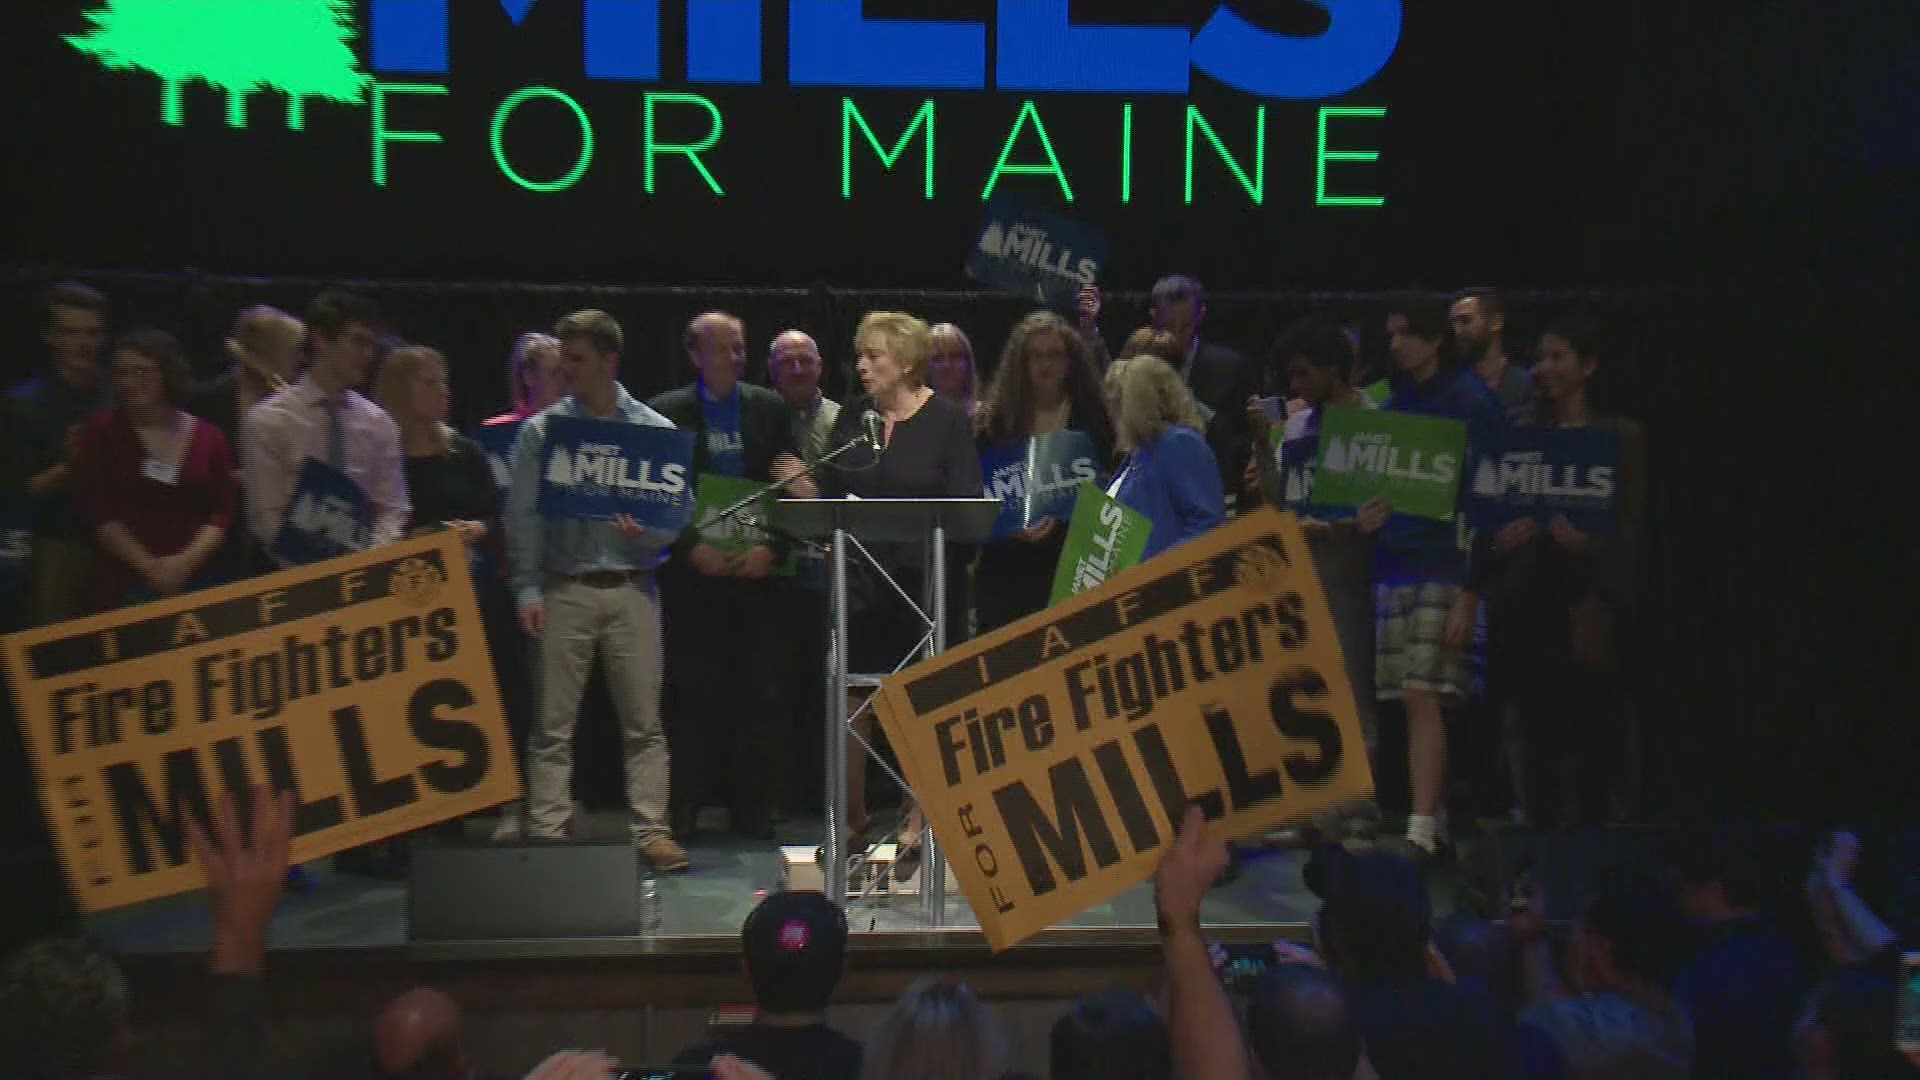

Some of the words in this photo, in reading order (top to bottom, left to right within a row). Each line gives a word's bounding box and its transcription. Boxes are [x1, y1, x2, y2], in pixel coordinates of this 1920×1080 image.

[368, 82, 727, 197] FOR
[840, 96, 1387, 207] MAINE
[1003, 231, 1097, 287] MILLS
[572, 454, 687, 495] MILLS
[993, 457, 1096, 502] MILLS
[1347, 443, 1457, 484] MILLS
[1499, 463, 1616, 497] MILLS
[48, 679, 175, 755] Fire
[192, 607, 458, 720] Fighters
[935, 692, 1055, 788] Fire
[1062, 591, 1310, 733] Fighters
[101, 678, 492, 876] MILLS
[991, 665, 1344, 897] MILLS
[957, 801, 1017, 914] FOR
